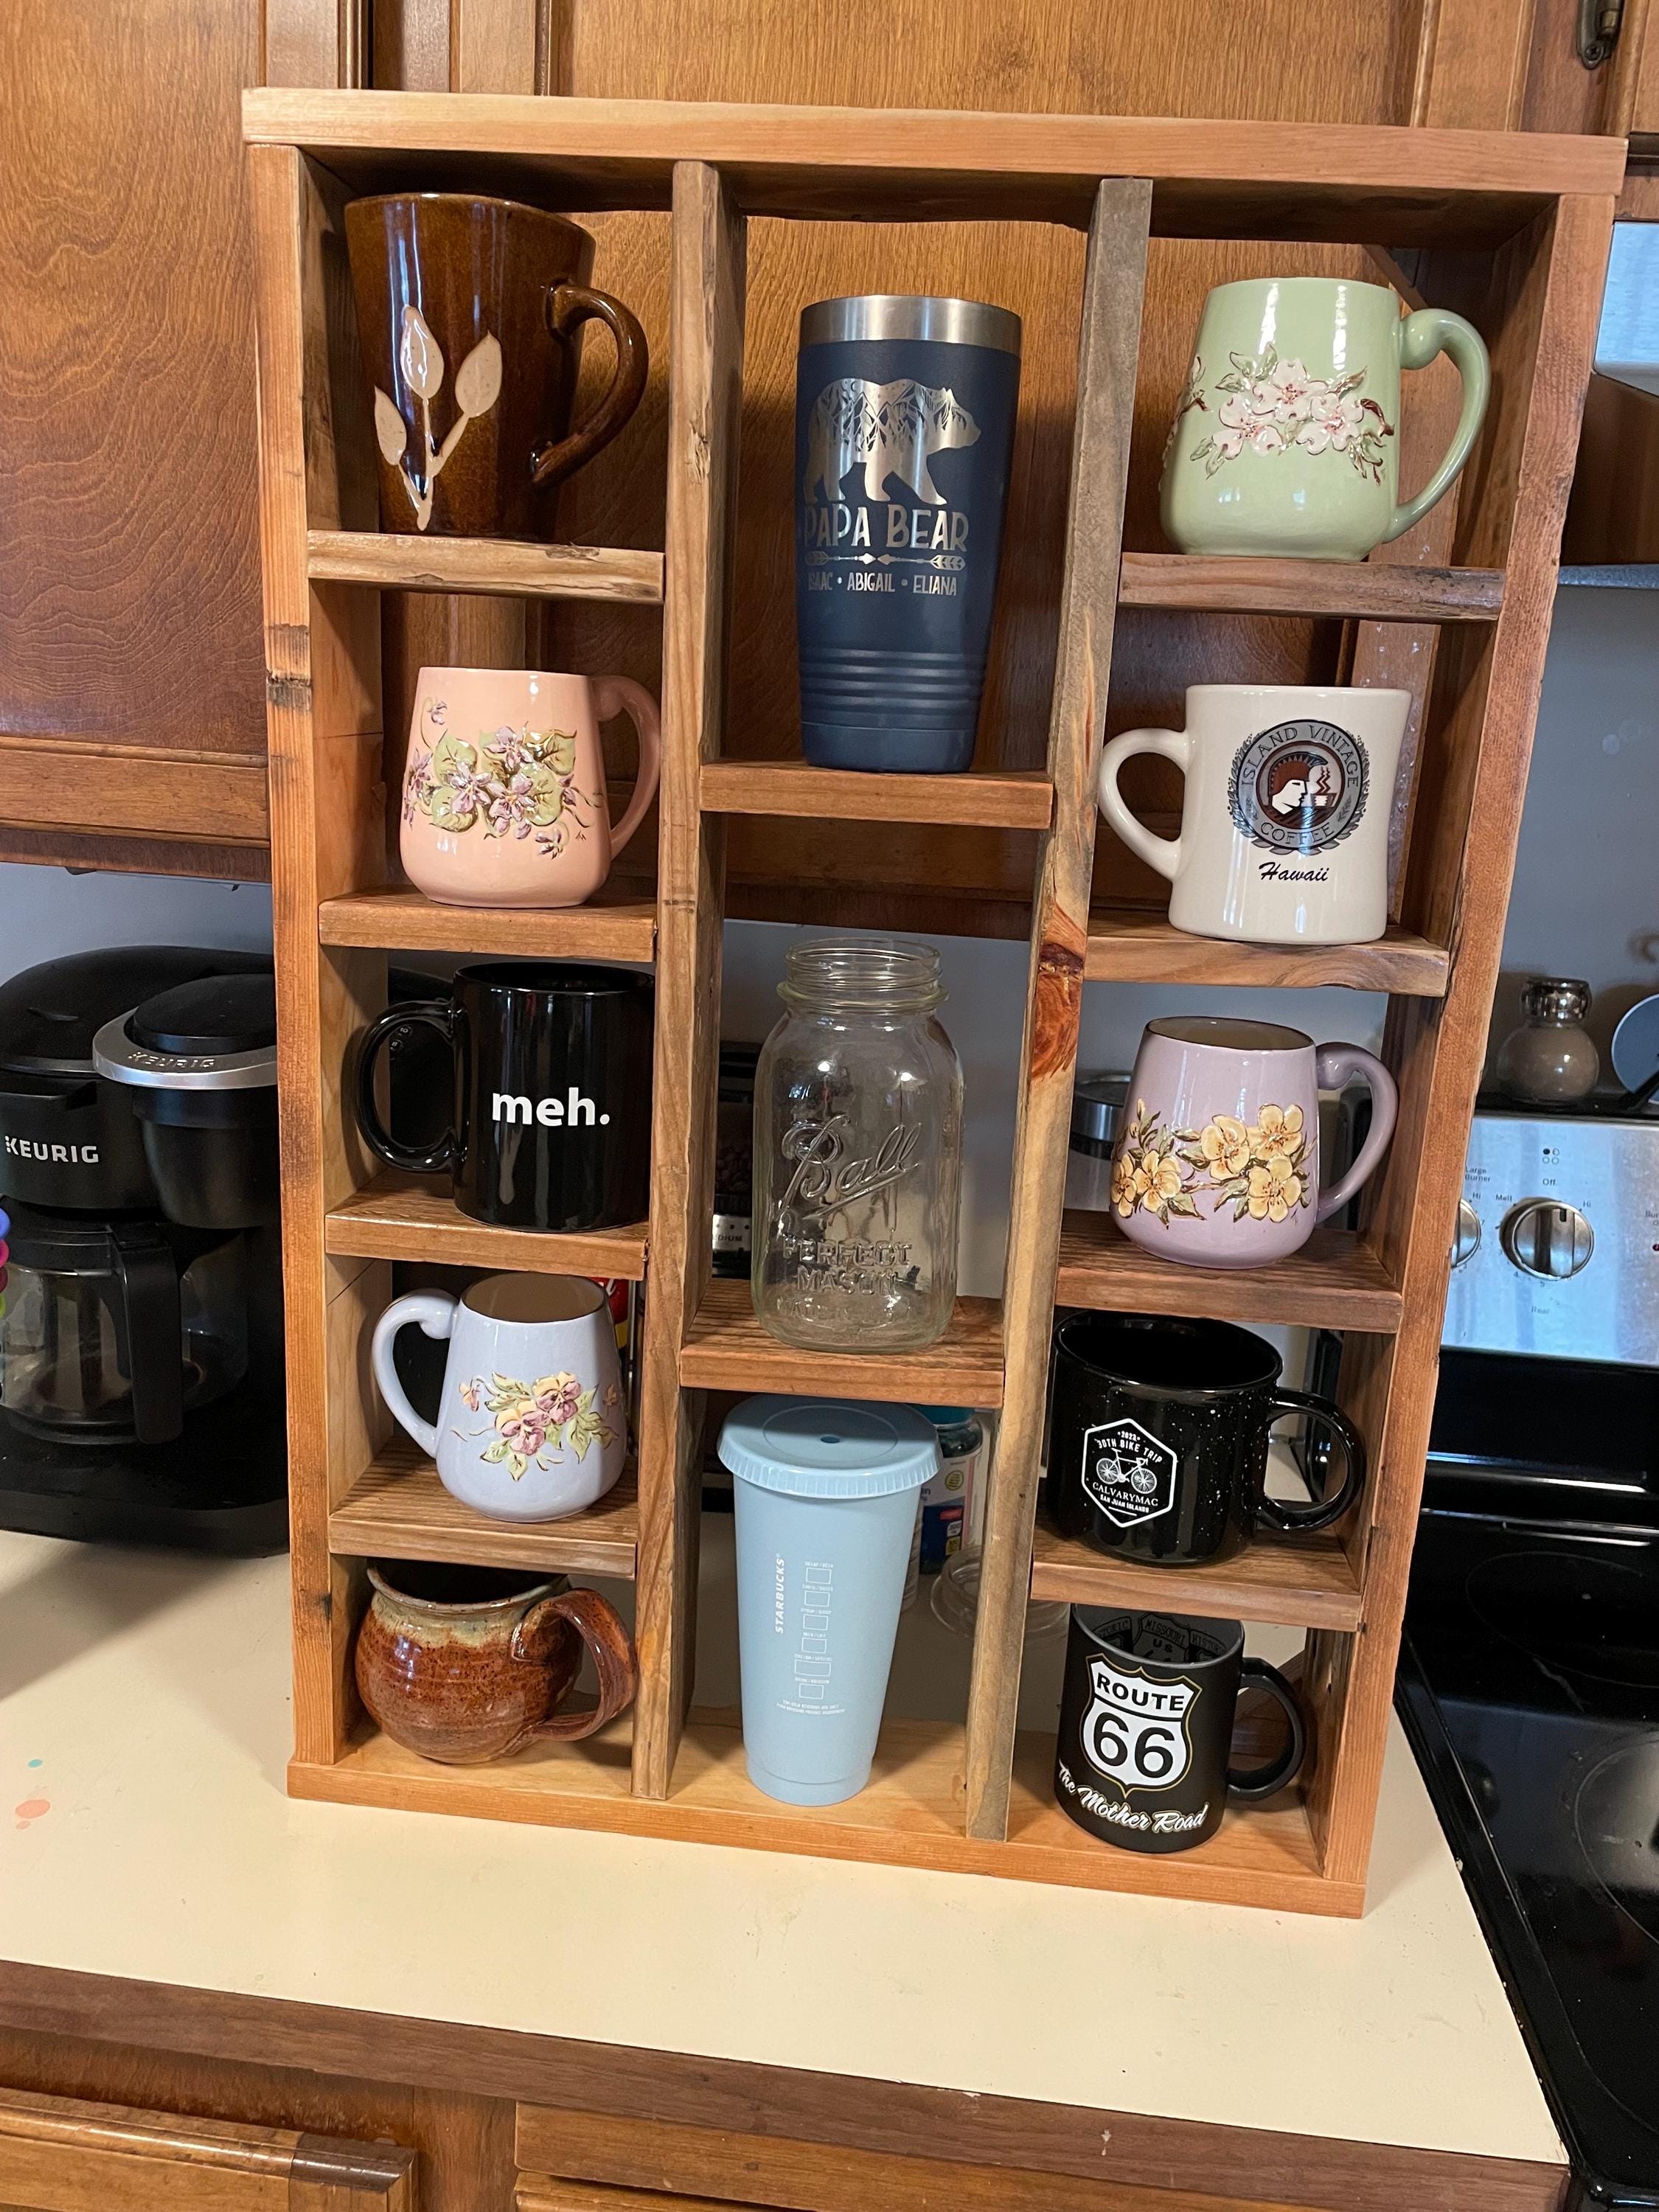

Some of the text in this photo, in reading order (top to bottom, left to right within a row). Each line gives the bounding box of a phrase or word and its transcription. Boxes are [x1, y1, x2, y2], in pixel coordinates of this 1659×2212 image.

[804, 503, 969, 552] PAPA BEAR
[847, 571, 896, 592] ABIGAIL
[913, 574, 958, 597] ELIANA
[1242, 725, 1358, 788] ISLAND VINTAGE
[1260, 821, 1335, 845] COFFEE
[1259, 861, 1330, 882] Hawaii
[128, 1051, 215, 1068] KEURIG
[492, 1087, 611, 1127] meh.
[4, 1135, 99, 1164] KEURIG
[777, 1114, 922, 1220] Ball
[1466, 1166, 1487, 1175] Large
[1472, 1191, 1481, 1200] Hi
[1542, 1178, 1557, 1186] Off
[1495, 1193, 1512, 1202] Melt
[782, 1237, 913, 1267] PERFECT
[797, 1265, 897, 1295] MASON
[1097, 1438, 1163, 1463] 30TH BIKE TRIP
[1093, 1481, 1158, 1506] CALVARYMAC
[775, 1557, 785, 1635] STARBUCKS
[1096, 1672, 1185, 1711] ROUTE
[1093, 1711, 1175, 1778] 66
[1058, 1758, 1210, 1834] The Mother Road
